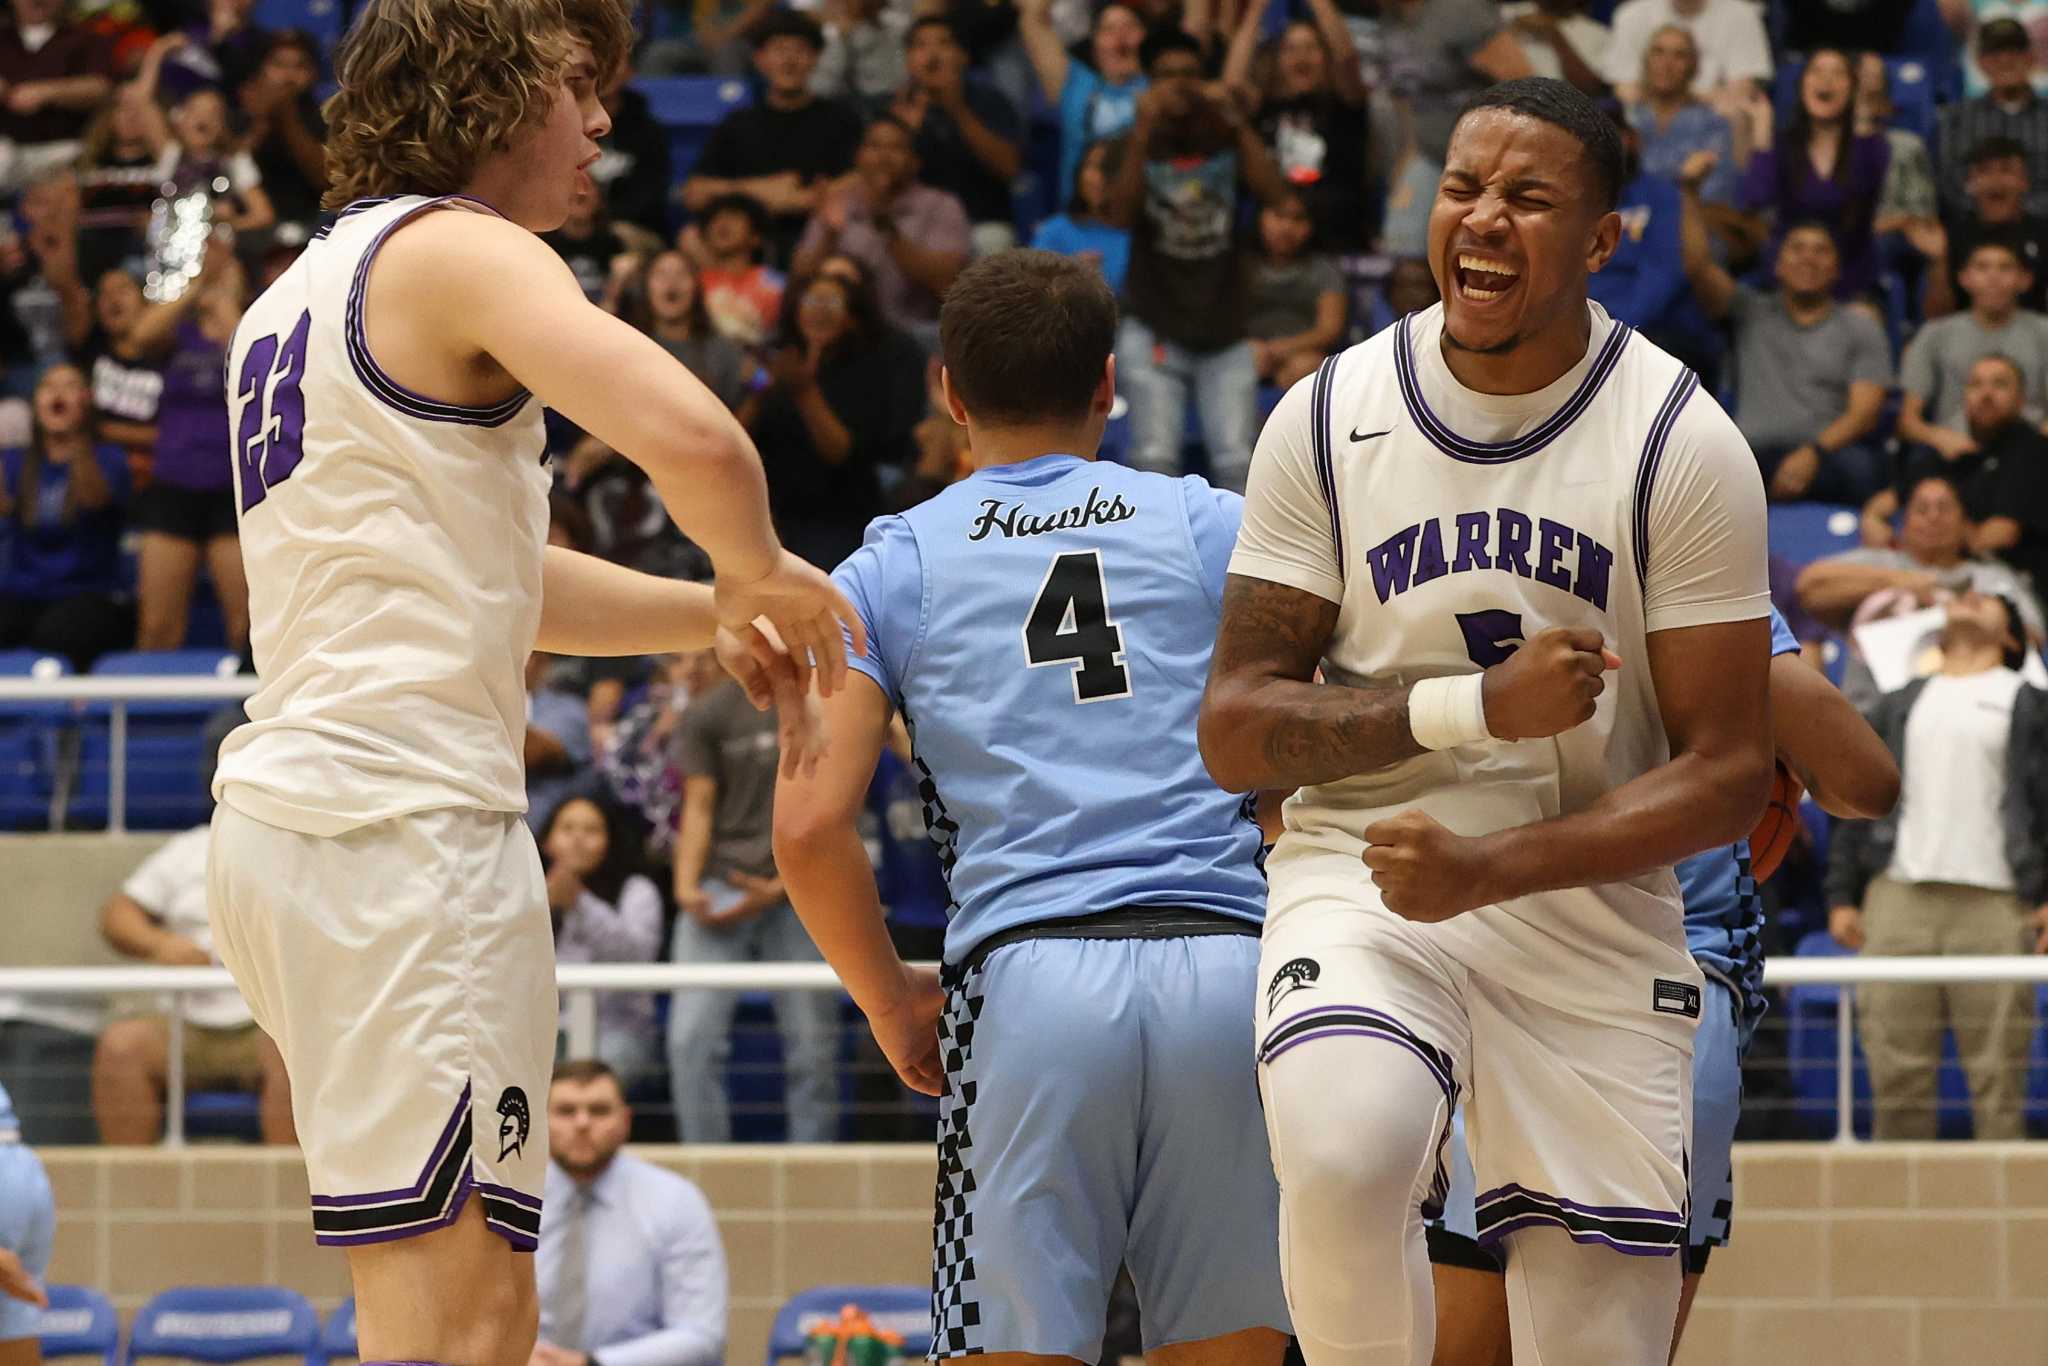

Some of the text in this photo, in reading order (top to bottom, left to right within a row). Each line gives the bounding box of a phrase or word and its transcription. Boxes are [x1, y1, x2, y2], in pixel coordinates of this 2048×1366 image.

[238, 306, 312, 516] 23
[968, 485, 1136, 542] Hawks
[1366, 507, 1614, 614] WARREN
[1020, 547, 1133, 705] 4
[1688, 993, 1698, 1009] XL
